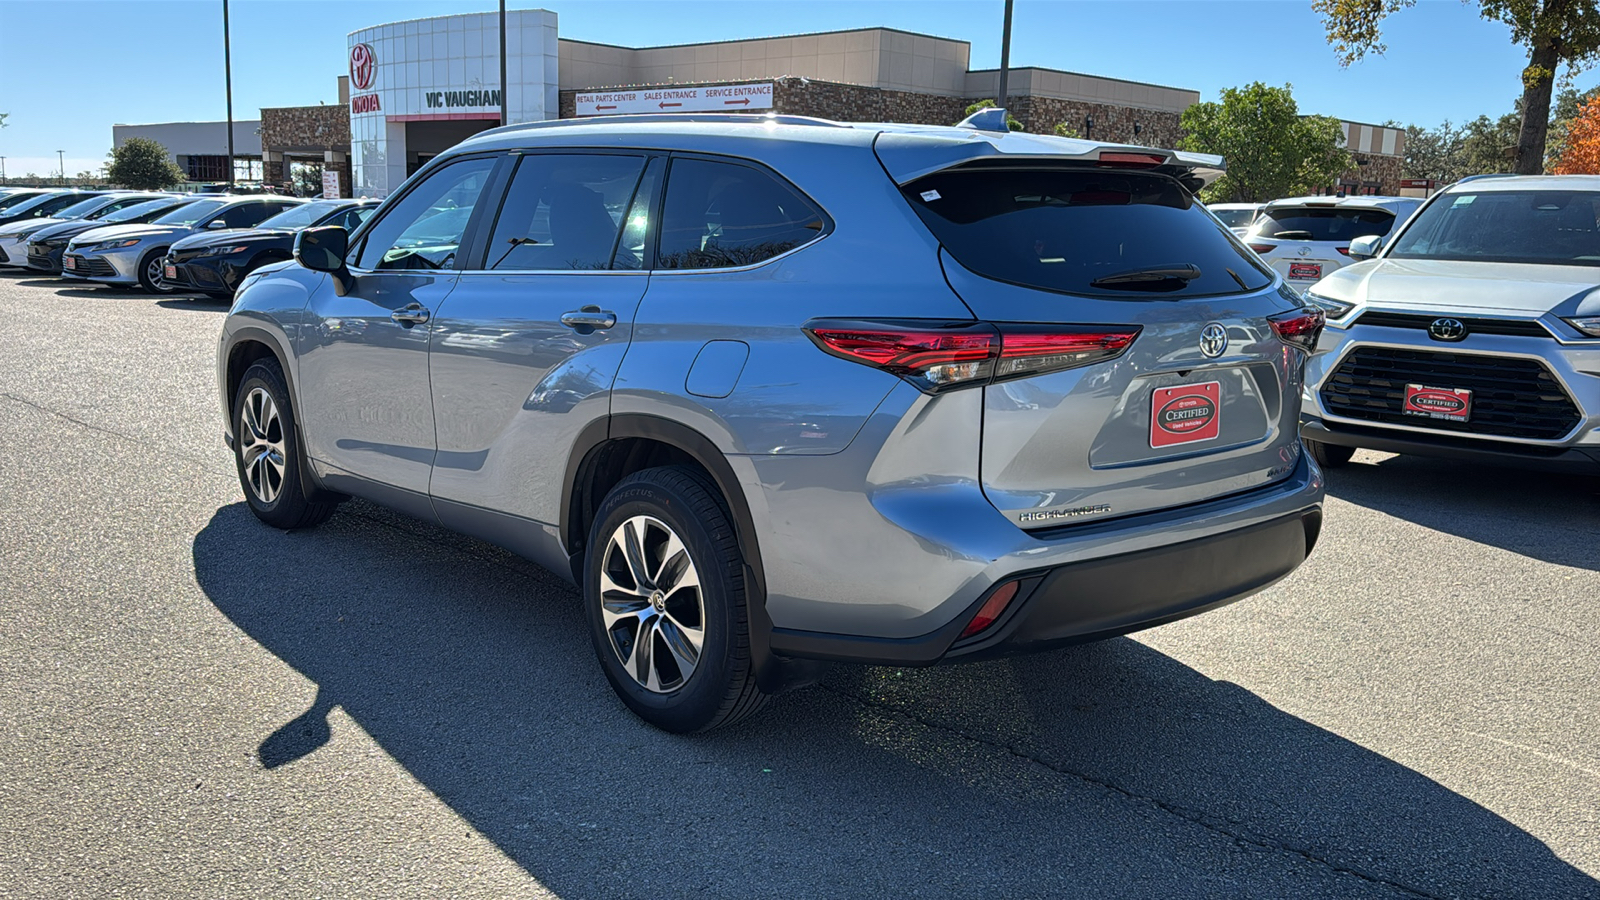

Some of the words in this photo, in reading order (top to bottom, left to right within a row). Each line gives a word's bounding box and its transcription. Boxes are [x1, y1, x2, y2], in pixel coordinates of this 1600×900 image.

[426, 91, 443, 108] VIC
[444, 89, 501, 107] VAUGHAN
[576, 95, 595, 104] RETAIL
[595, 94, 613, 103] PARTS
[613, 93, 637, 102] CENTER
[643, 91, 662, 100] SALES
[663, 90, 697, 99] ENTRANCE
[705, 88, 732, 98] SERVICE
[733, 86, 771, 96] ENTRANCE
[352, 93, 382, 114] TOYOTA
[1165, 407, 1209, 421] CERTIFIED
[605, 488, 654, 512] PERFECTUS
[1019, 503, 1112, 522] HIGHLANDER
